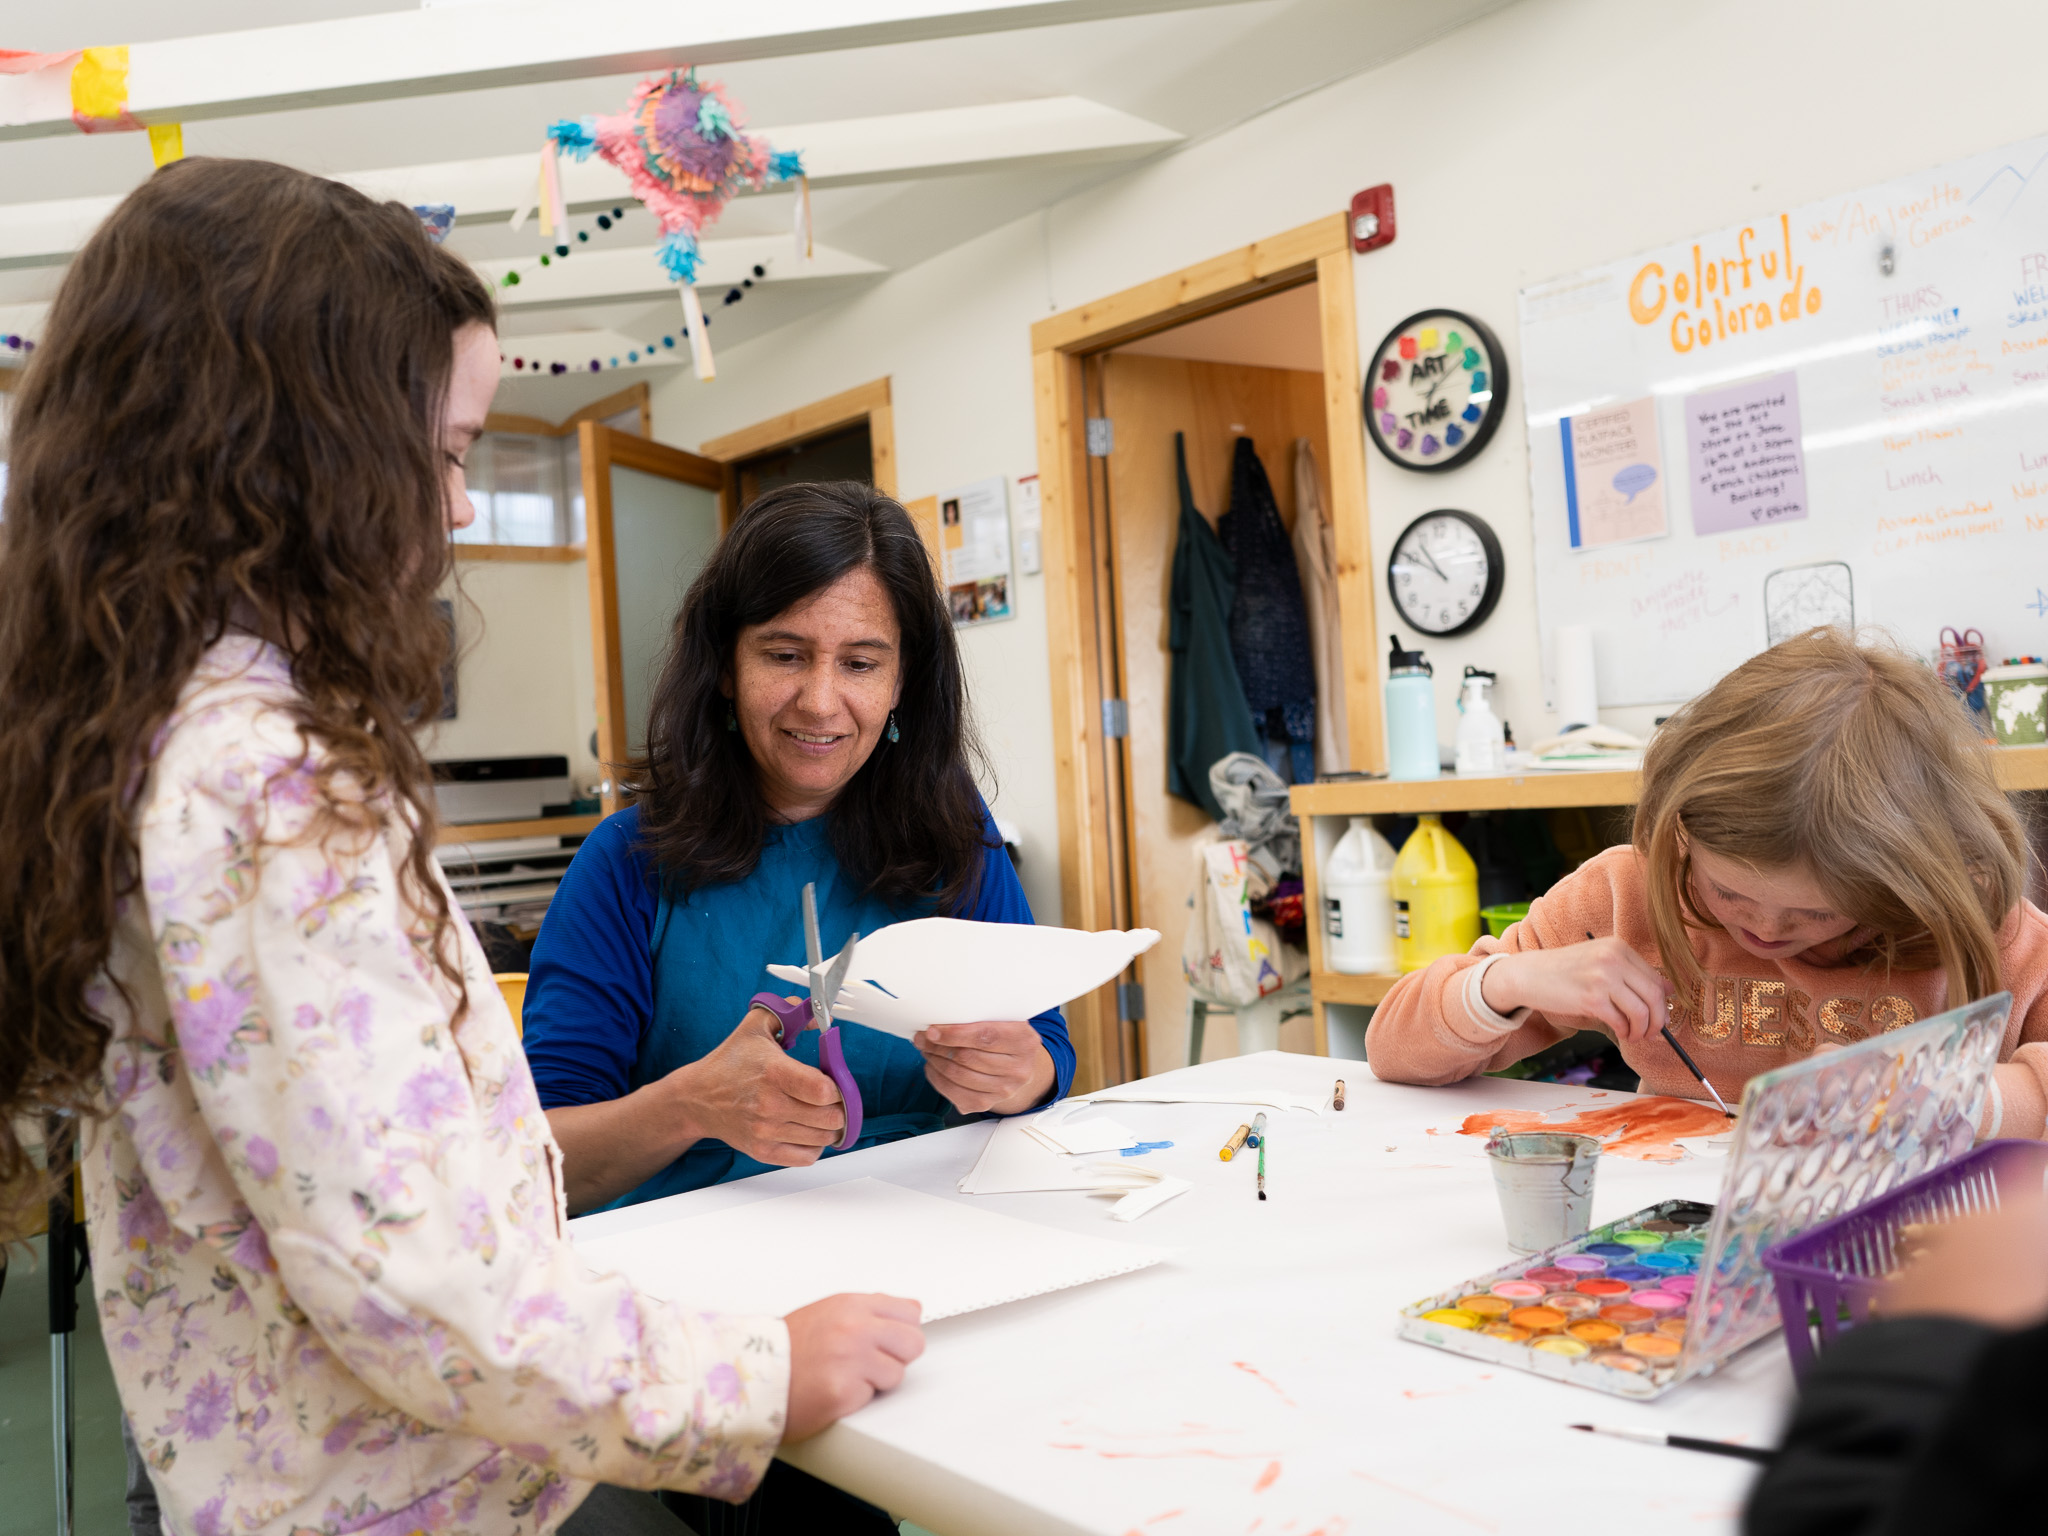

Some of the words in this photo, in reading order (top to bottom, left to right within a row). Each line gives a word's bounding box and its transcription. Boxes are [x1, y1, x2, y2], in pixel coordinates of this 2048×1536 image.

[1629, 213, 1793, 325] Colorful
[1671, 265, 1822, 354] Colorado
[1878, 284, 1945, 319] THURS
[1409, 354, 1448, 387] ART
[1405, 398, 1450, 428] TIME
[1744, 393, 1786, 412] invited
[1885, 463, 1944, 491] Lunch
[1431, 521, 1447, 540] 12
[1719, 530, 1789, 563] BACK!
[1407, 591, 1419, 608] 8
[1469, 582, 1481, 597] 4
[1420, 603, 1432, 620] 7
[1439, 607, 1451, 625] 6
[1457, 599, 1468, 617] 5
[1656, 966, 1918, 1052] UESS?
